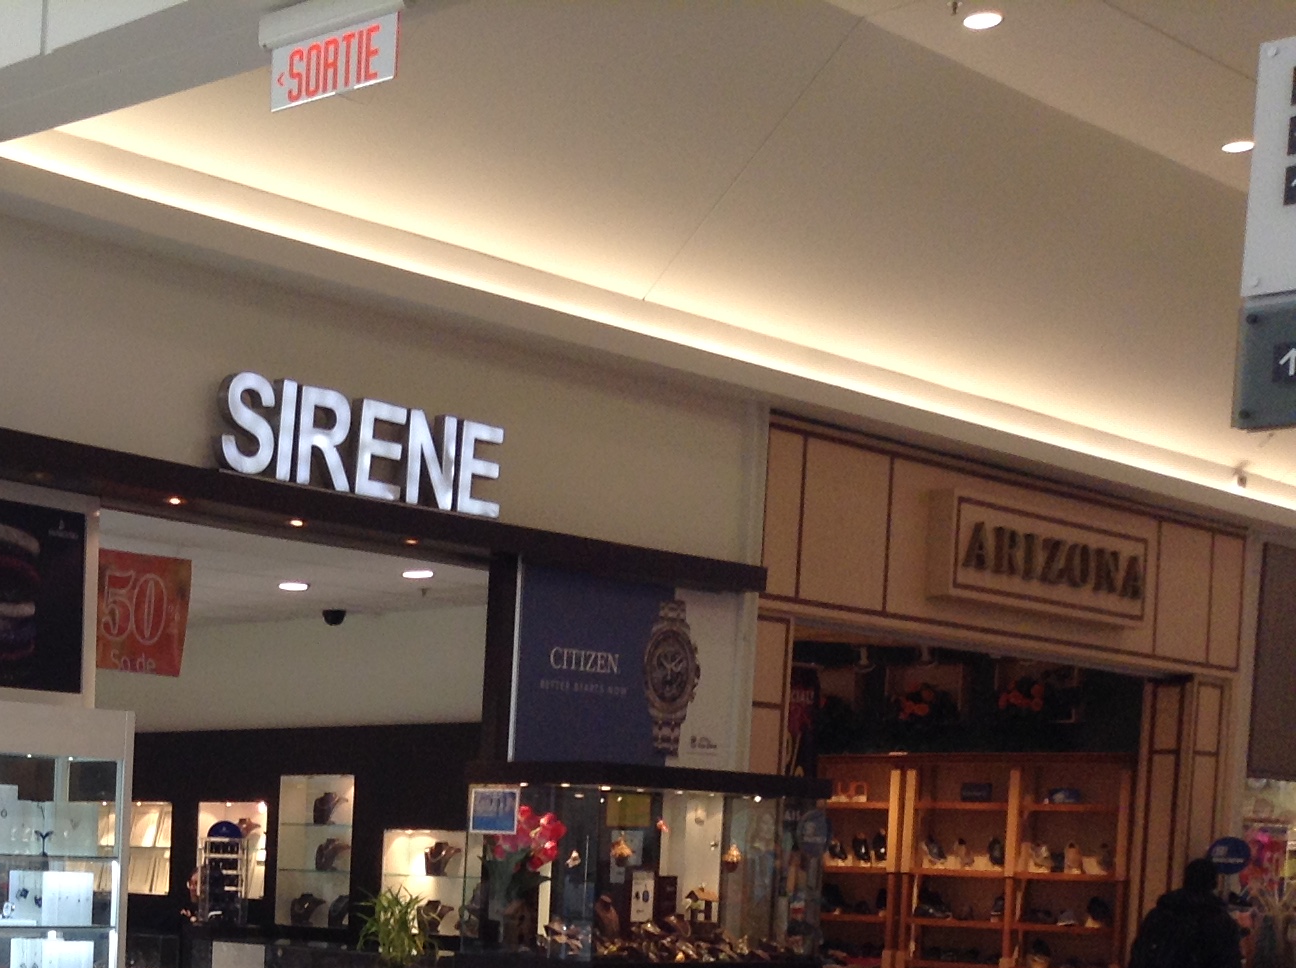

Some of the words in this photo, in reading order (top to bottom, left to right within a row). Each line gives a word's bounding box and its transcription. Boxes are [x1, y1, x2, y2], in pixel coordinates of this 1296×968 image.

[287, 23, 381, 102] SORTIE
[219, 370, 504, 518] SIRENE
[961, 521, 1144, 600] ARIZONA
[549, 646, 620, 674] CITIZEN
